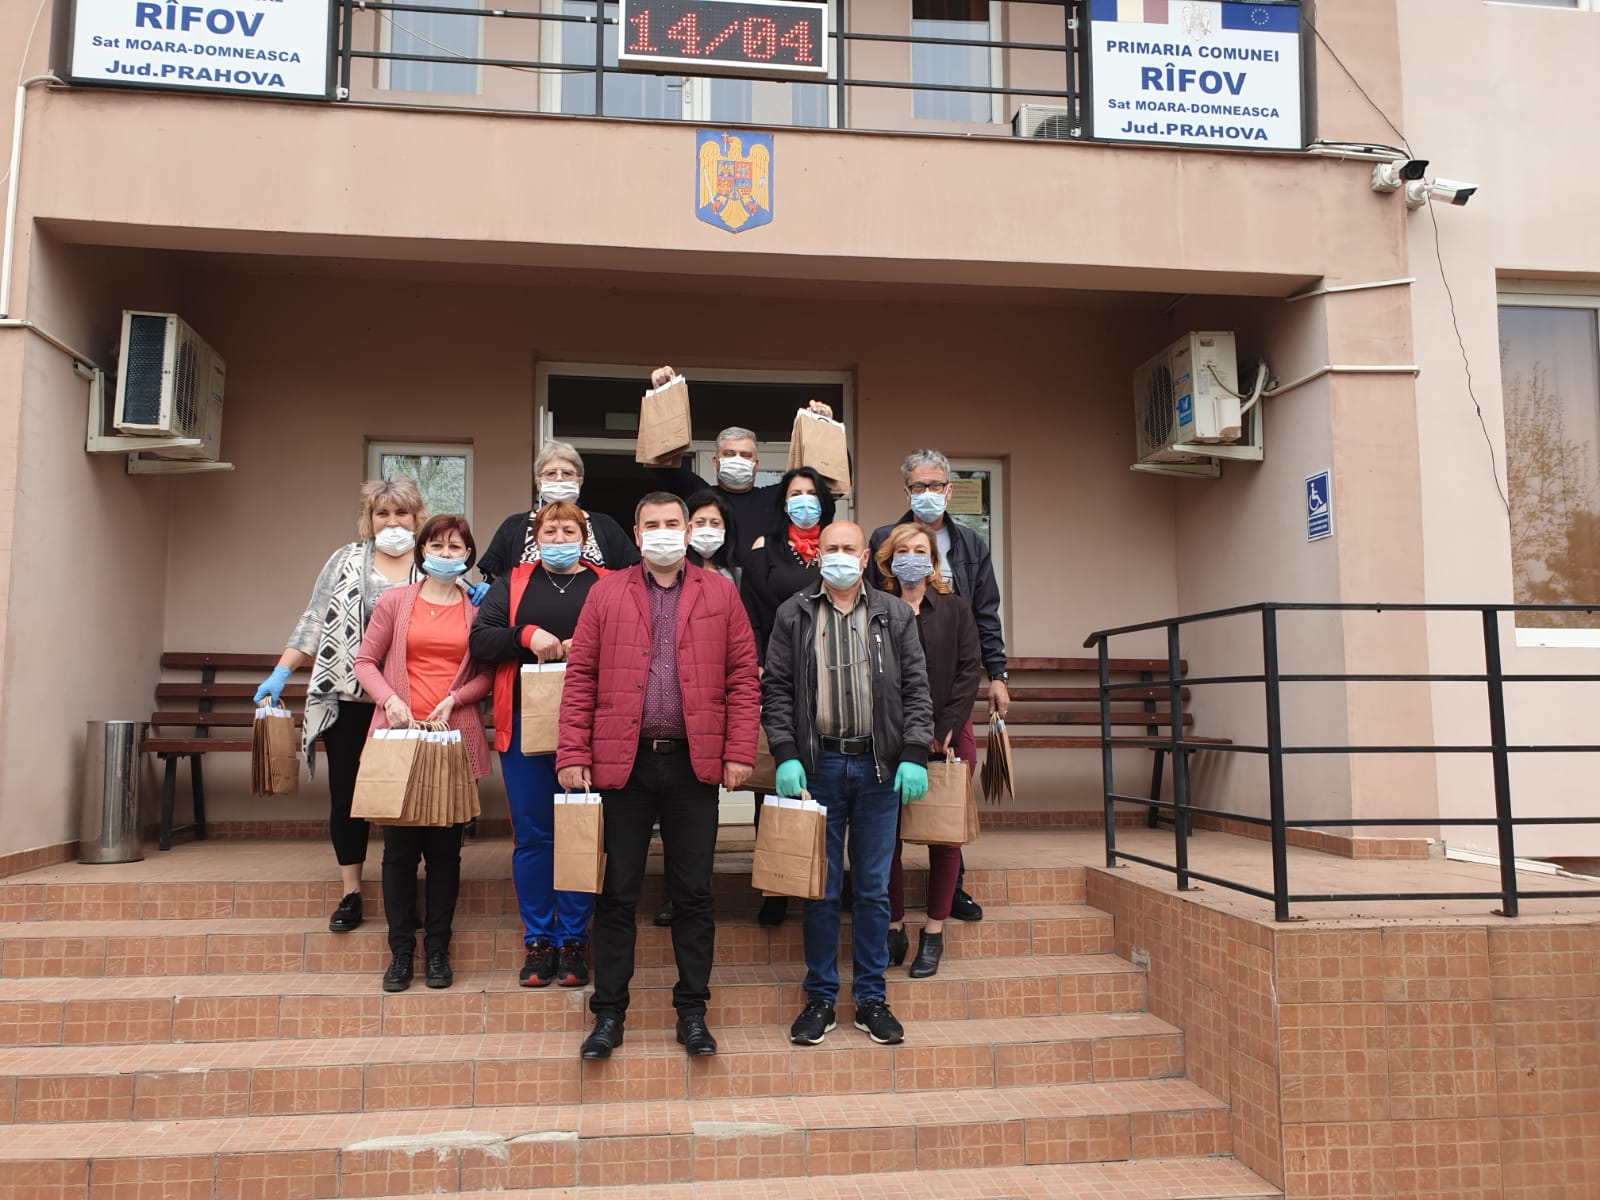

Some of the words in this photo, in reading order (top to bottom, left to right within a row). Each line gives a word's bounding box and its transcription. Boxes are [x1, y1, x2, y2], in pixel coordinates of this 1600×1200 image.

[135, 0, 265, 37] RÎFOV
[92, 35, 120, 48] Sat
[125, 38, 301, 63] MOARA-DOMNEASCA
[629, 10, 814, 62] 14/04
[1106, 40, 1193, 57] PRIMARIA
[1198, 46, 1280, 62] COMUNEI
[105, 60, 285, 87] Jud.PRAHOVA
[1141, 62, 1247, 95] RÎFOV
[1108, 99, 1131, 110] Sat
[1135, 100, 1280, 118] MOARA-DOMNEASCA
[1120, 120, 1269, 141] Jud.PRAHOVA
